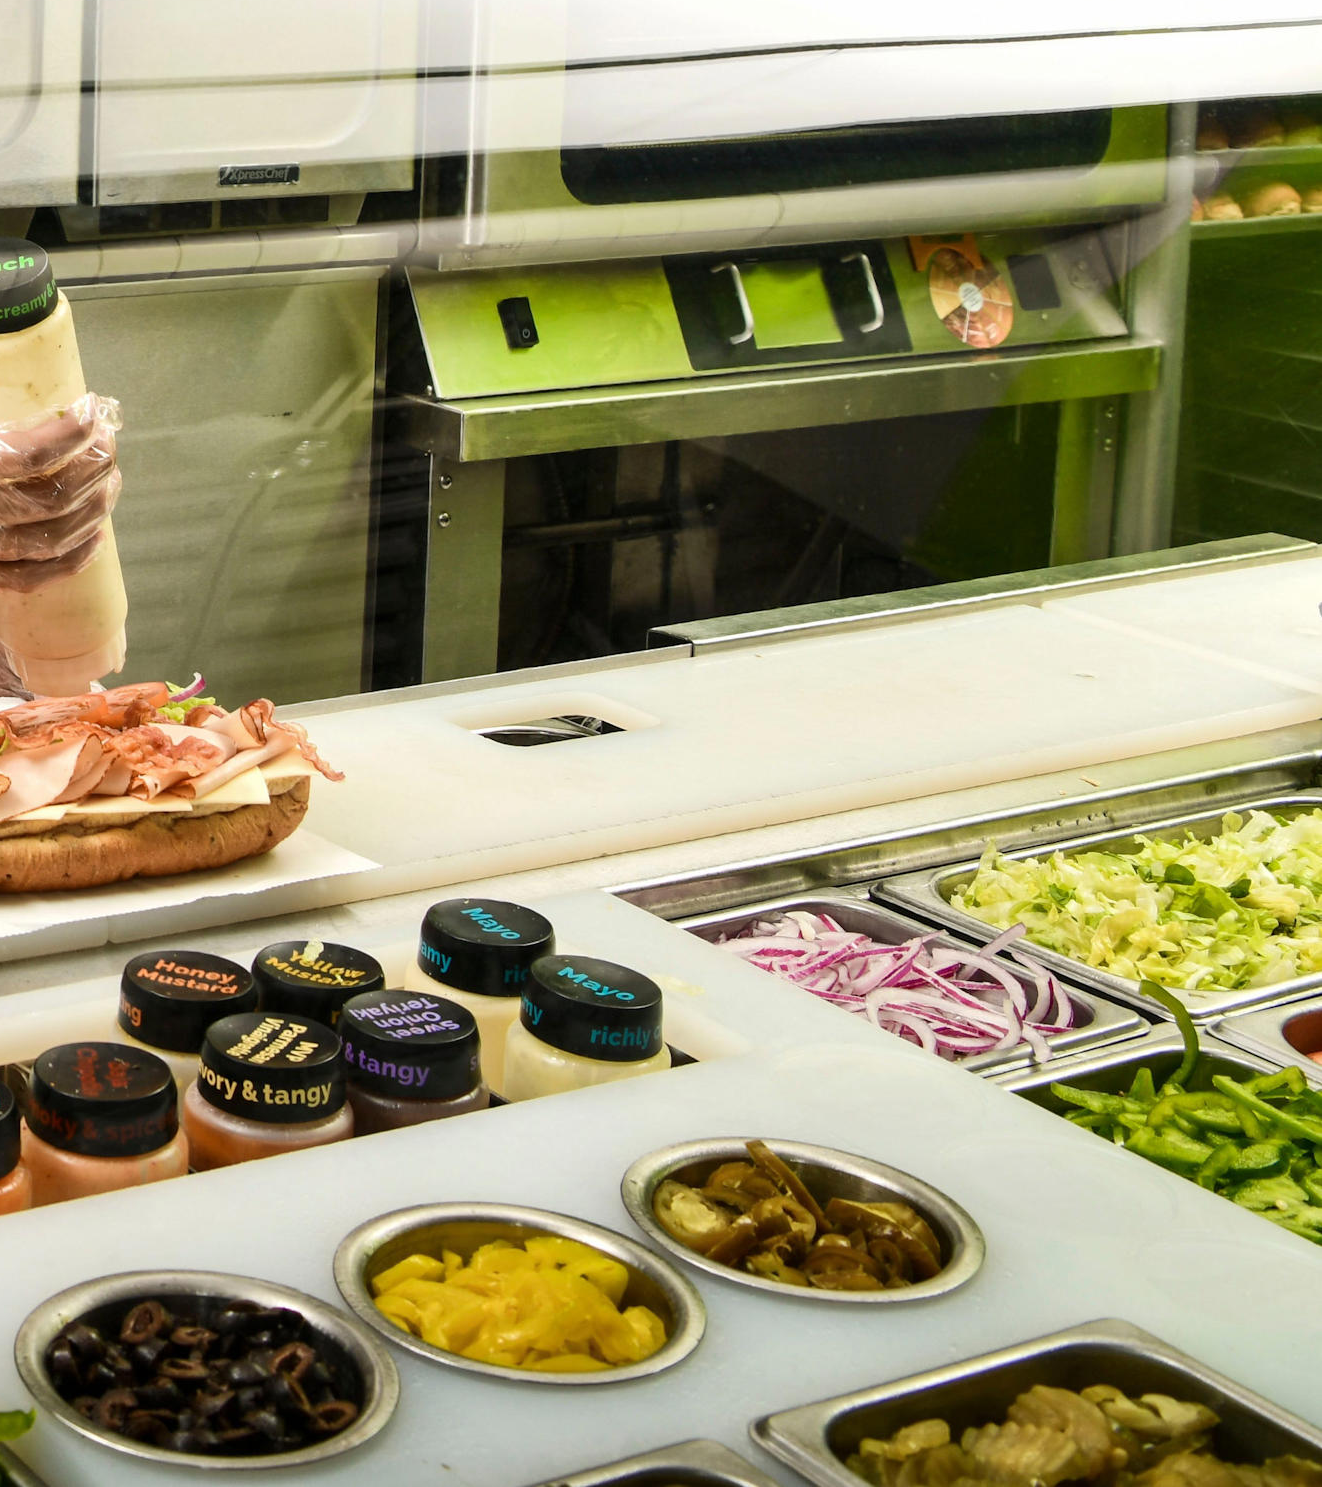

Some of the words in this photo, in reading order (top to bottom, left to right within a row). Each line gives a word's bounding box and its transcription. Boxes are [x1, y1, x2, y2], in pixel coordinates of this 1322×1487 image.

[460, 907, 521, 939] Mayo
[137, 968, 238, 994] Mustard
[155, 958, 236, 984] Honey
[265, 956, 360, 986] Mustard
[557, 966, 635, 1000] Mayo
[348, 997, 439, 1021] Teriyaki
[373, 1011, 441, 1028] Onion
[386, 1020, 460, 1039] Sweet
[589, 1026, 650, 1049] richly
[248, 1023, 308, 1064] Parmesan
[285, 1041, 319, 1063] MVP
[358, 1050, 430, 1087] tangy
[242, 1079, 258, 1102] &
[263, 1082, 332, 1108] tangy
